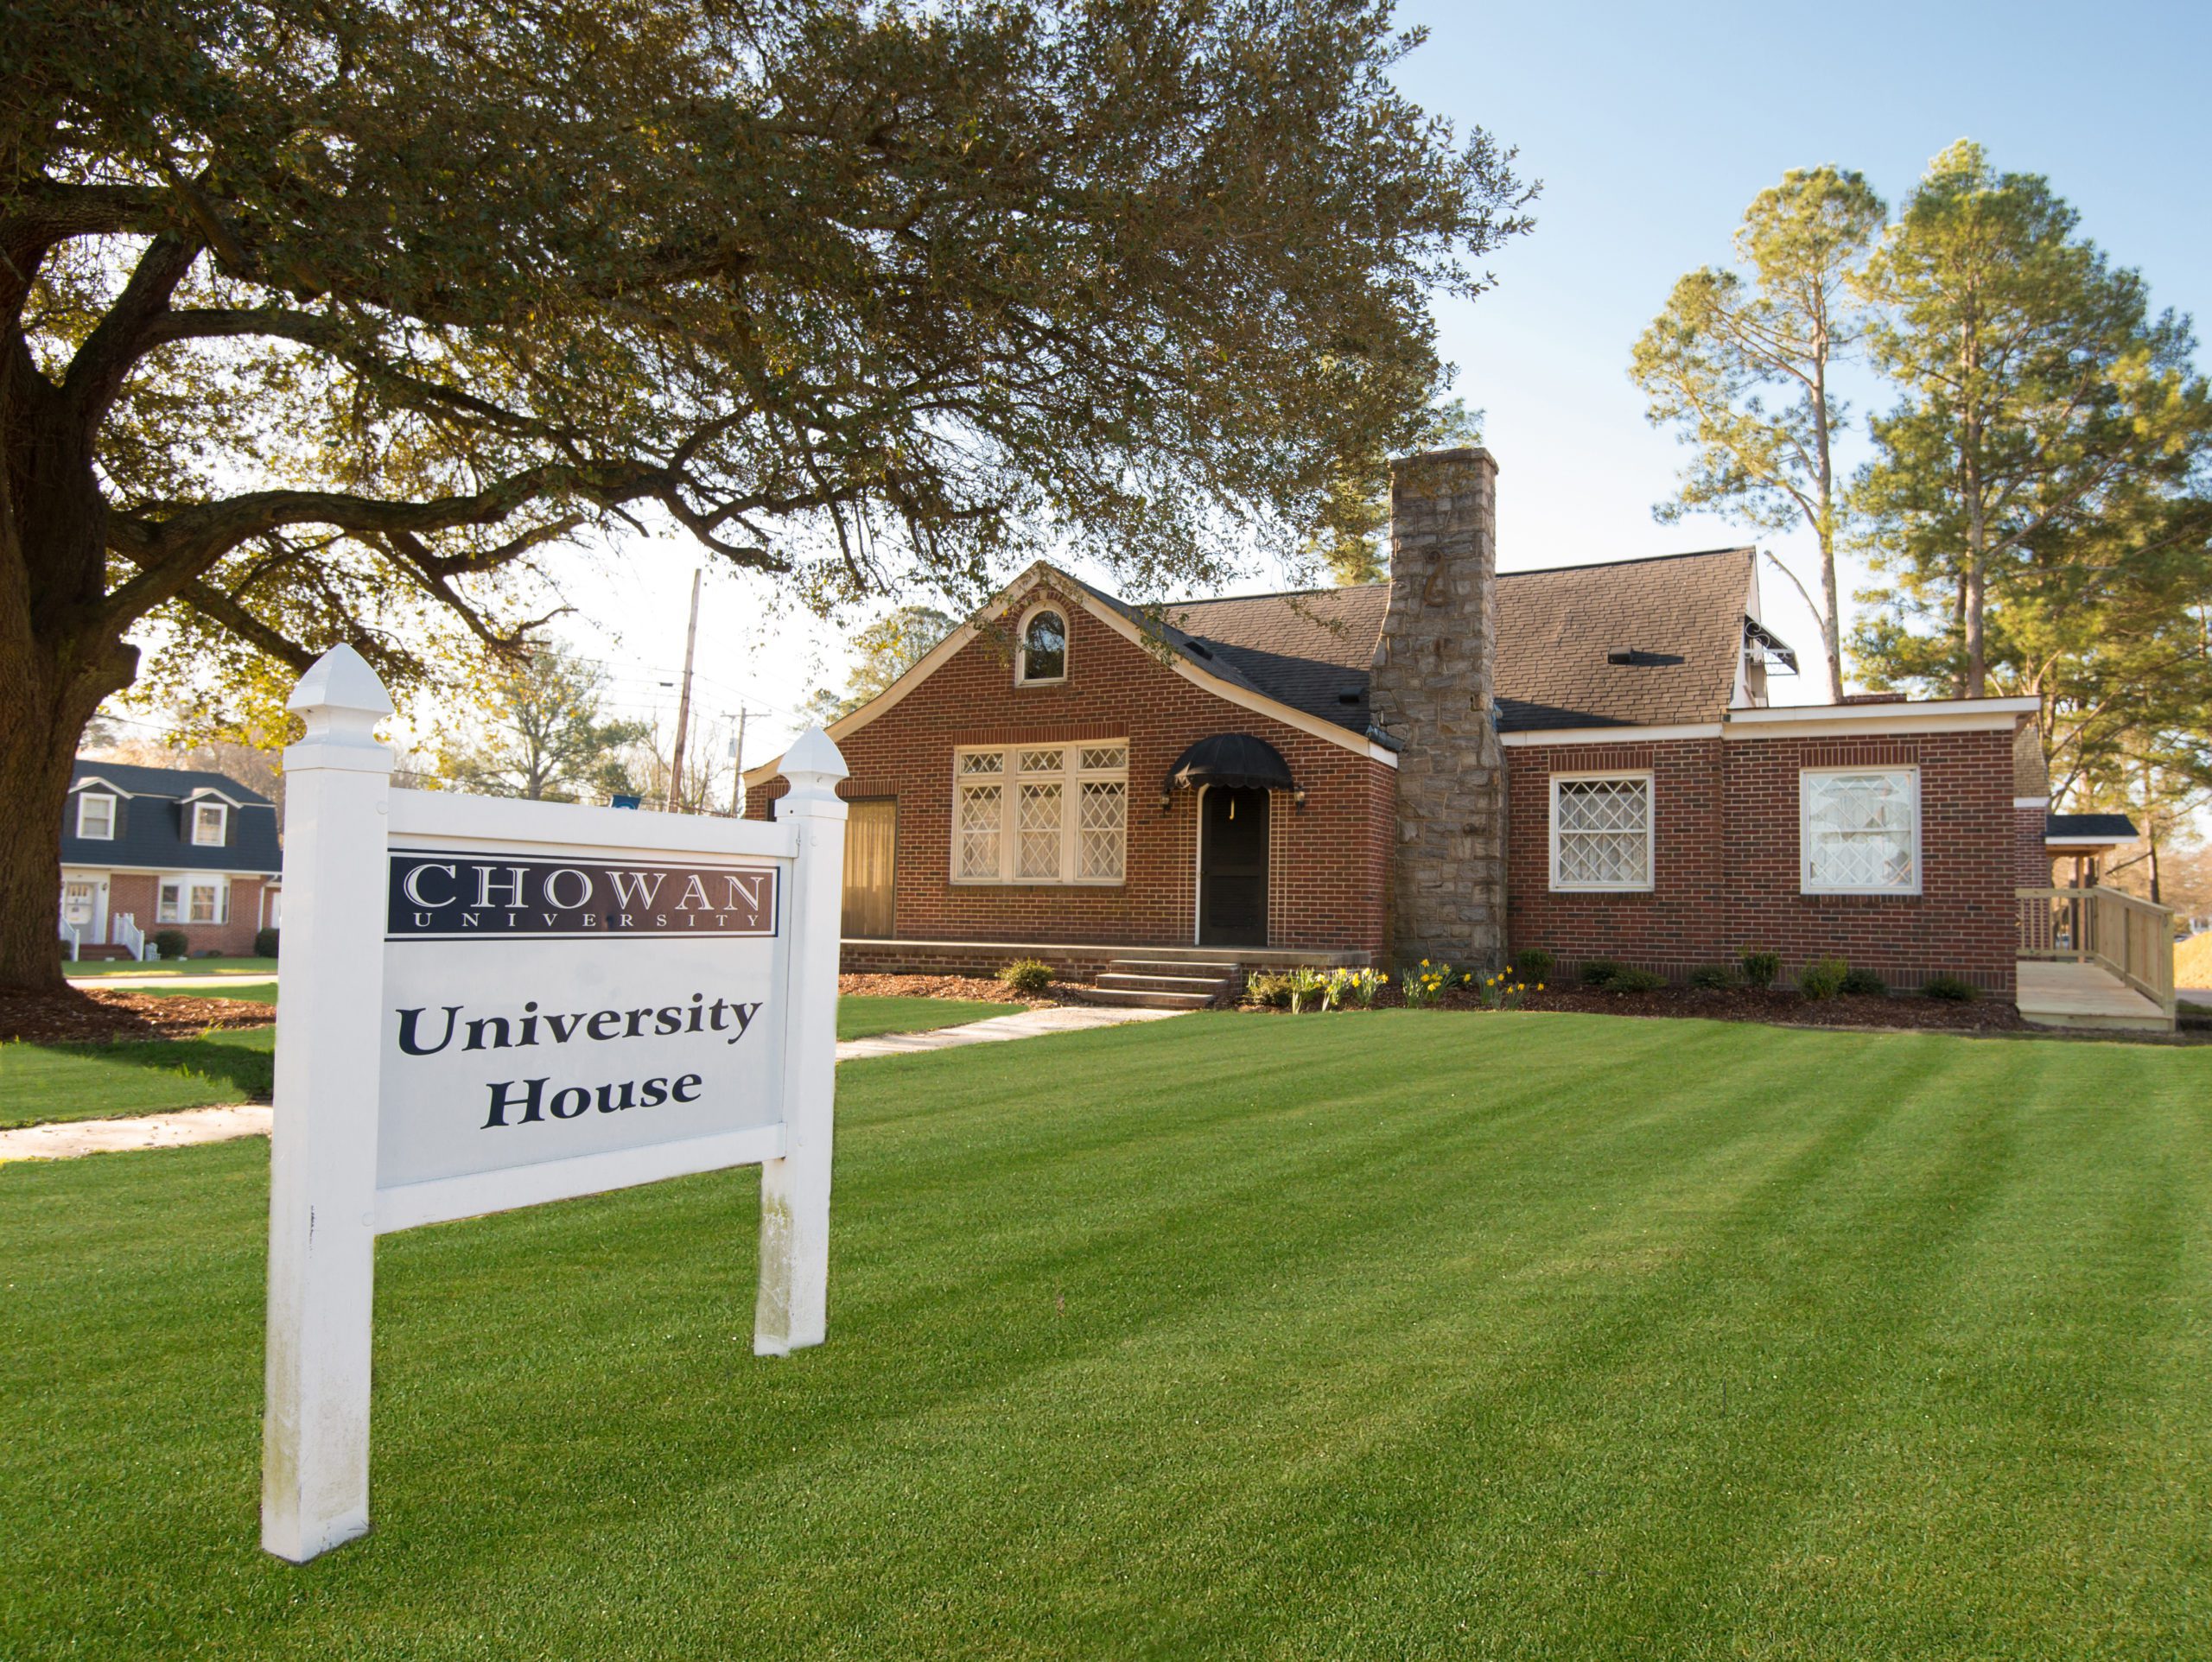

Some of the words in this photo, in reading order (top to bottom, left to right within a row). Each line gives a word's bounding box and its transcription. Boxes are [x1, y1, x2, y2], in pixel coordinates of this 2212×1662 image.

[404, 864, 765, 910] CHOWAN
[413, 912, 760, 927] UNIVERSITY
[395, 993, 763, 1056] University
[480, 1073, 702, 1129] House
